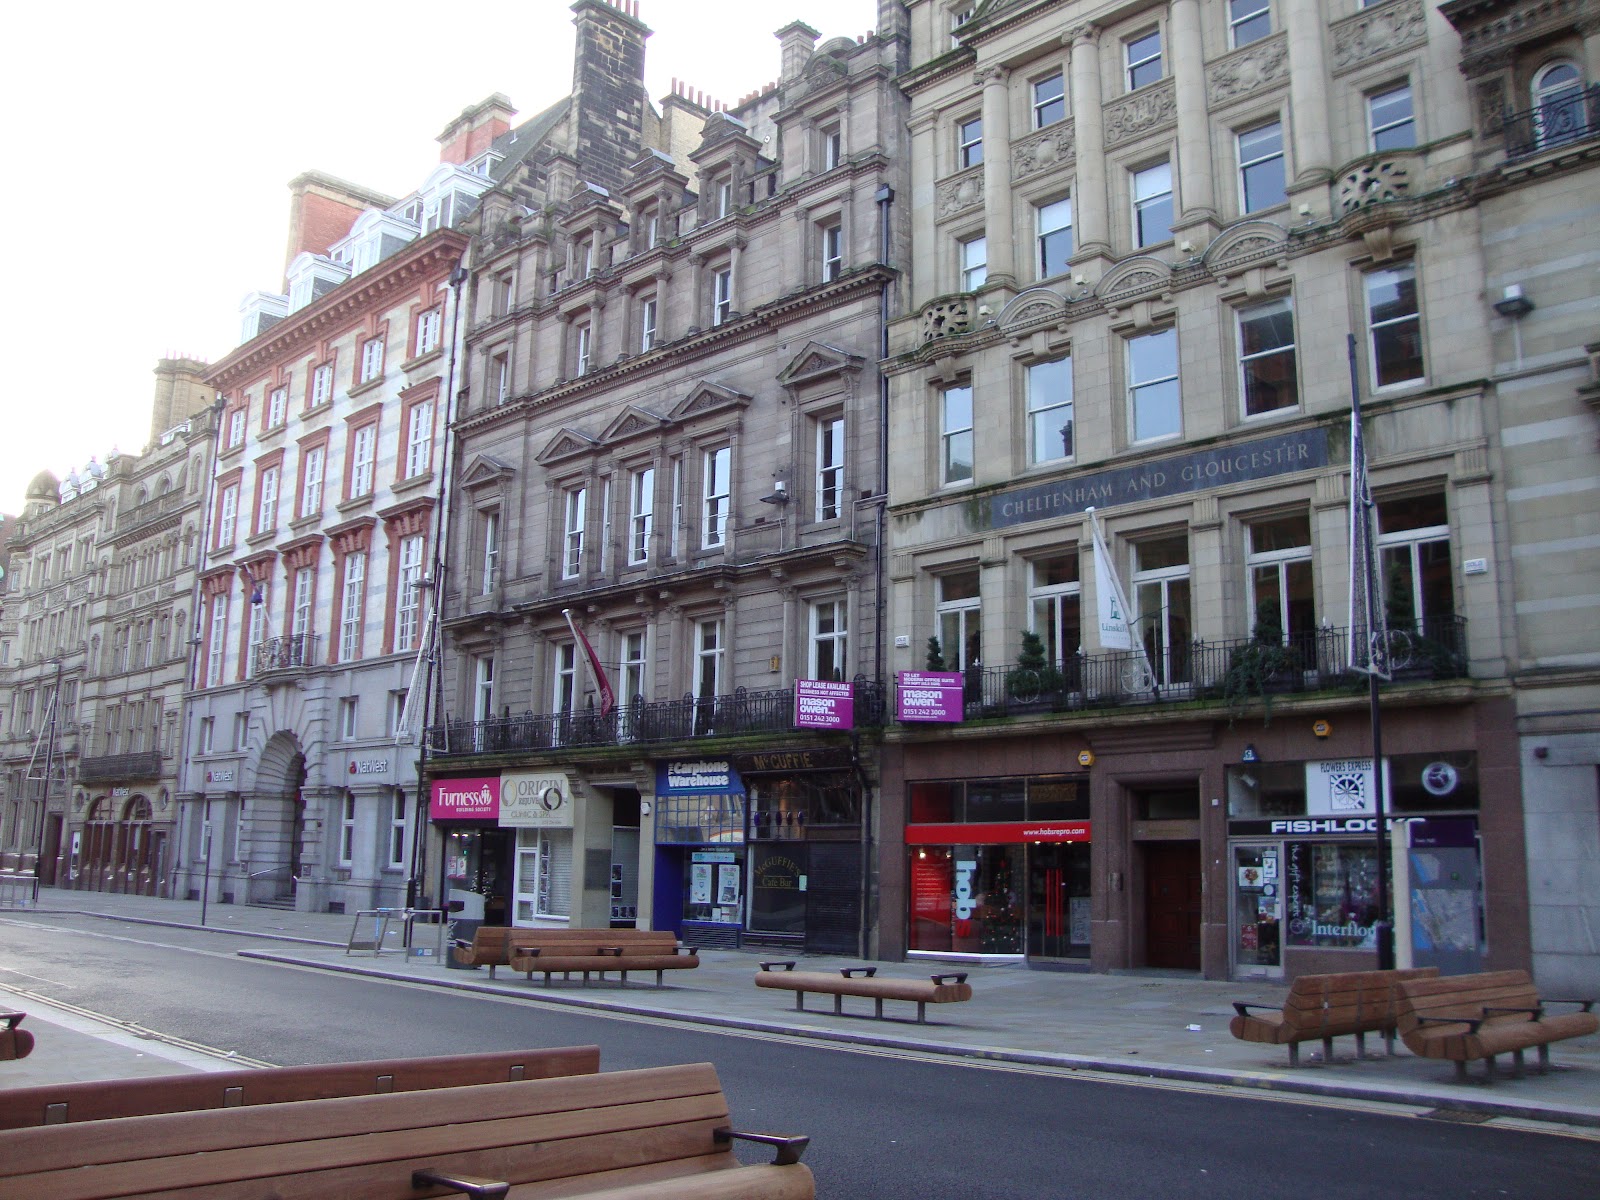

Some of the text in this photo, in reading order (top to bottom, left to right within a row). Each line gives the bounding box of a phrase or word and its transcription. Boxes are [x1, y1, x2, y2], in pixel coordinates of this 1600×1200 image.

[1002, 443, 1310, 517] CHELTENHAM AND GLOUCESTER
[827, 683, 850, 691] AVAILABLE
[903, 690, 943, 699] mason
[800, 697, 835, 707] mason
[356, 760, 387, 774] NatWest
[674, 760, 729, 776] Carphone
[1320, 760, 1372, 773] FLOWERS EXPRESS
[212, 770, 233, 782] NatWest
[668, 774, 729, 787] Warehouse
[112, 787, 129, 797] NatWest
[438, 787, 480, 807] Furness
[1023, 827, 1085, 837] www.hobsrepro.com
[956, 861, 976, 937] hobs
